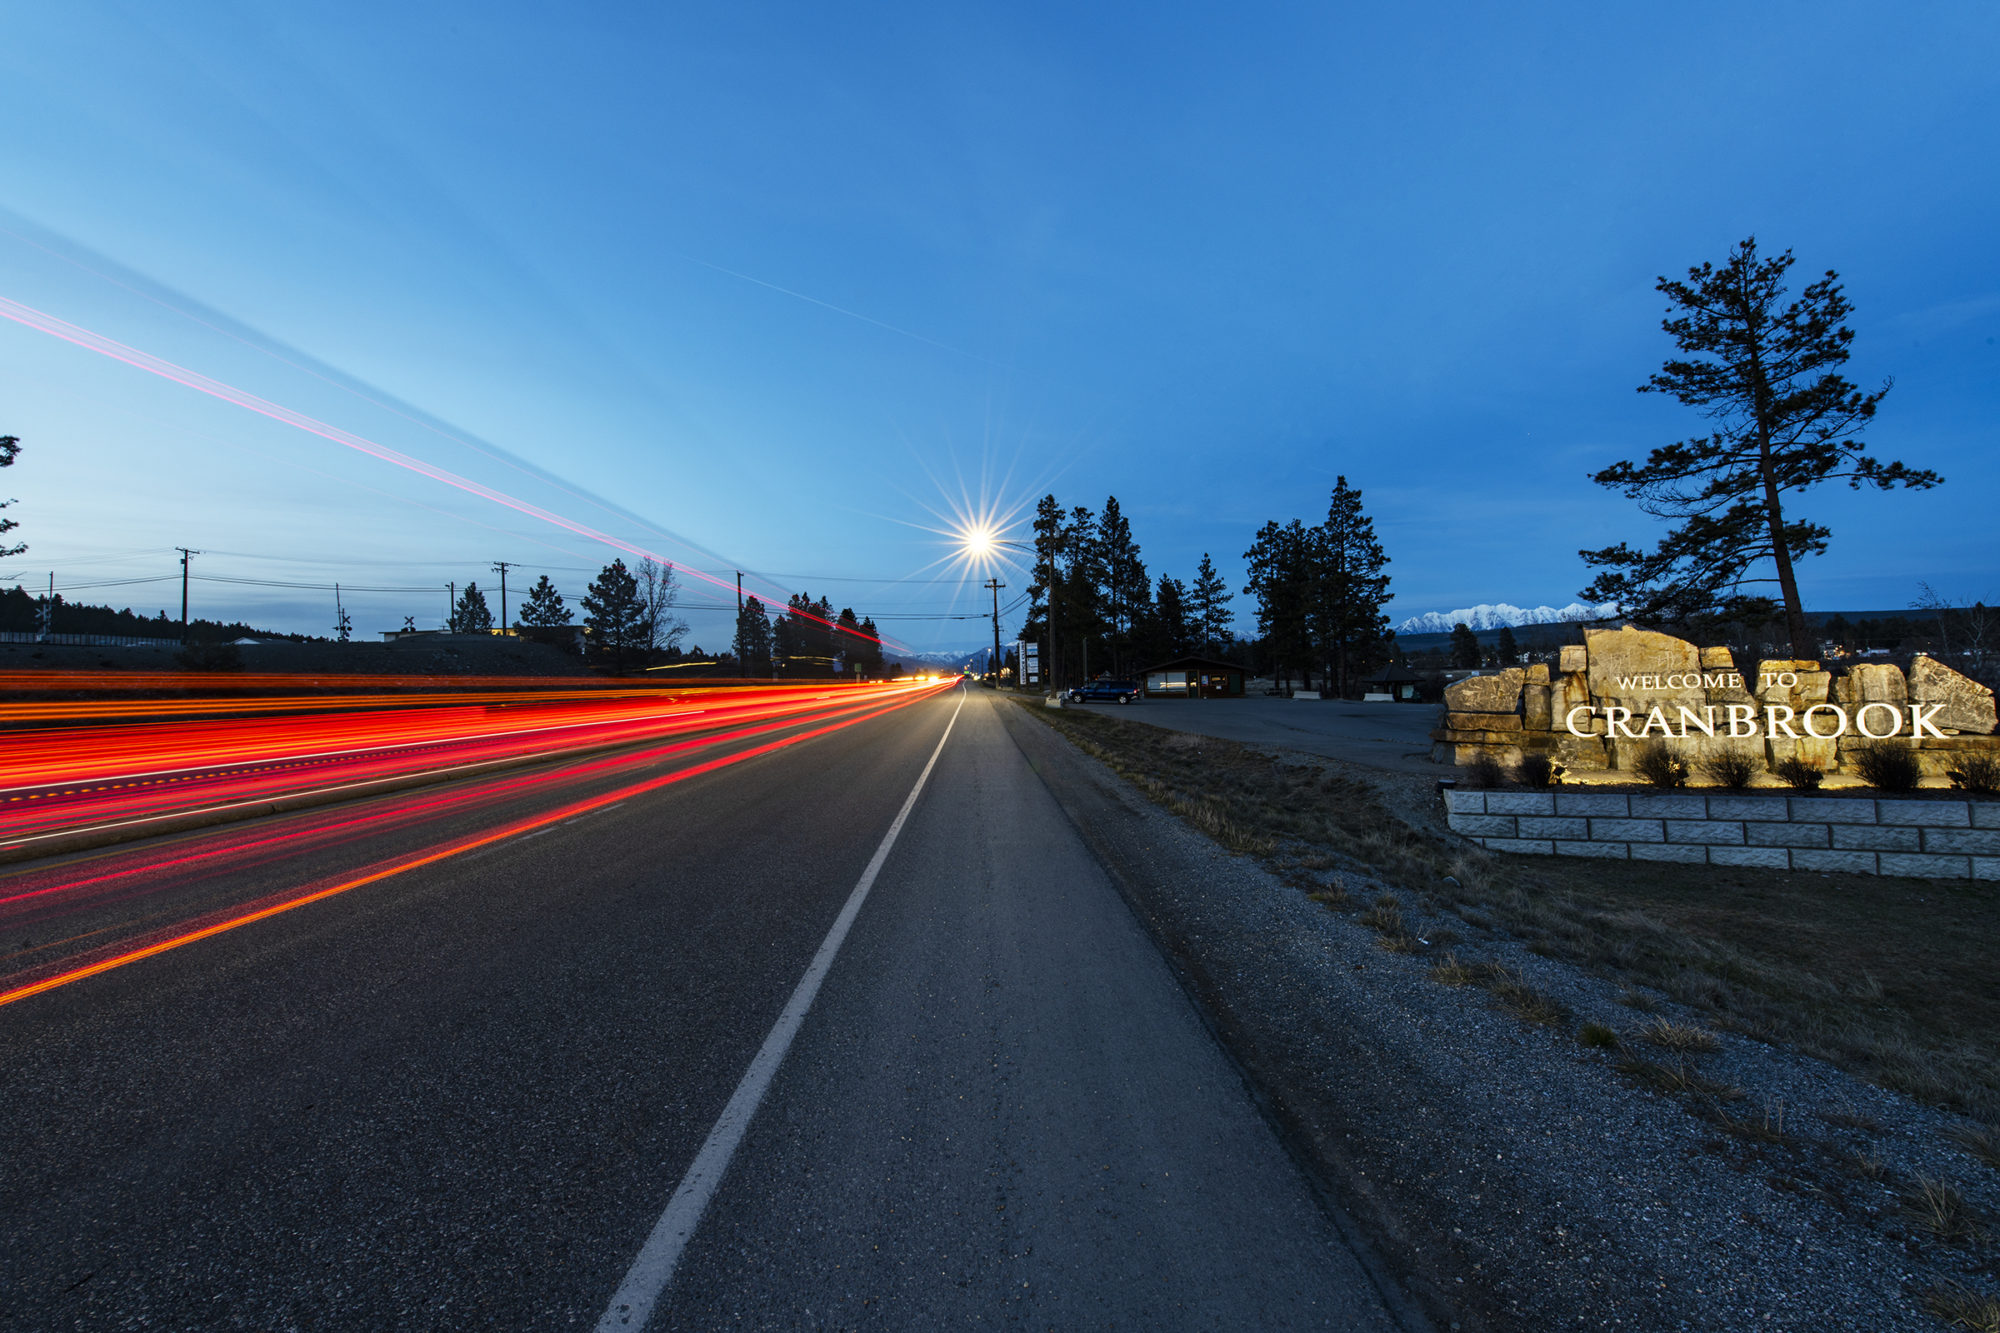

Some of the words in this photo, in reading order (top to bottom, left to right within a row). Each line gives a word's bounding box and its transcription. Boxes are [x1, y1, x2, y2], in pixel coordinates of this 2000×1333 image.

[1616, 672, 1742, 691] WELCOME
[1760, 672, 1798, 689] TO
[1566, 703, 1950, 739] CRANBROOK
